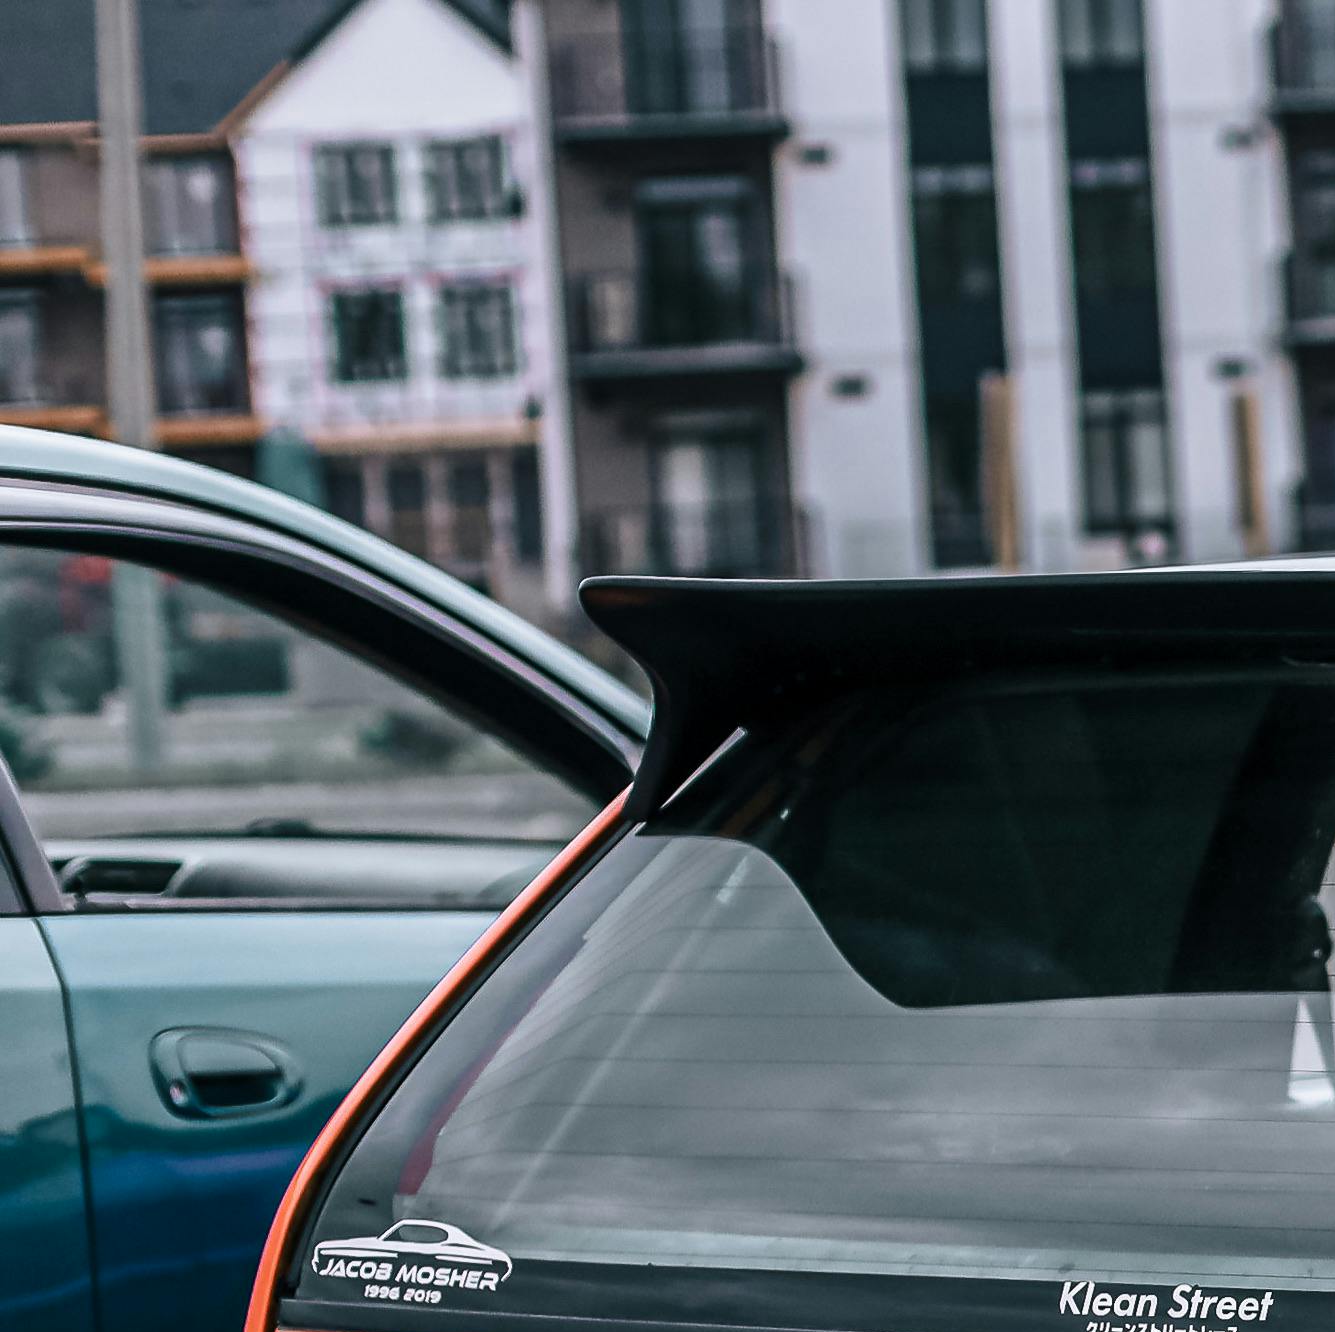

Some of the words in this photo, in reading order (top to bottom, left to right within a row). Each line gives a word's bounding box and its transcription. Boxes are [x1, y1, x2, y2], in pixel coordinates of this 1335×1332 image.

[319, 1258, 393, 1281] JACOB
[395, 1264, 500, 1291] MOSHER
[364, 1284, 400, 1301] 1996
[403, 1288, 442, 1304] 2019
[1059, 1280, 1158, 1317] Klean
[1167, 1283, 1275, 1321] Street
